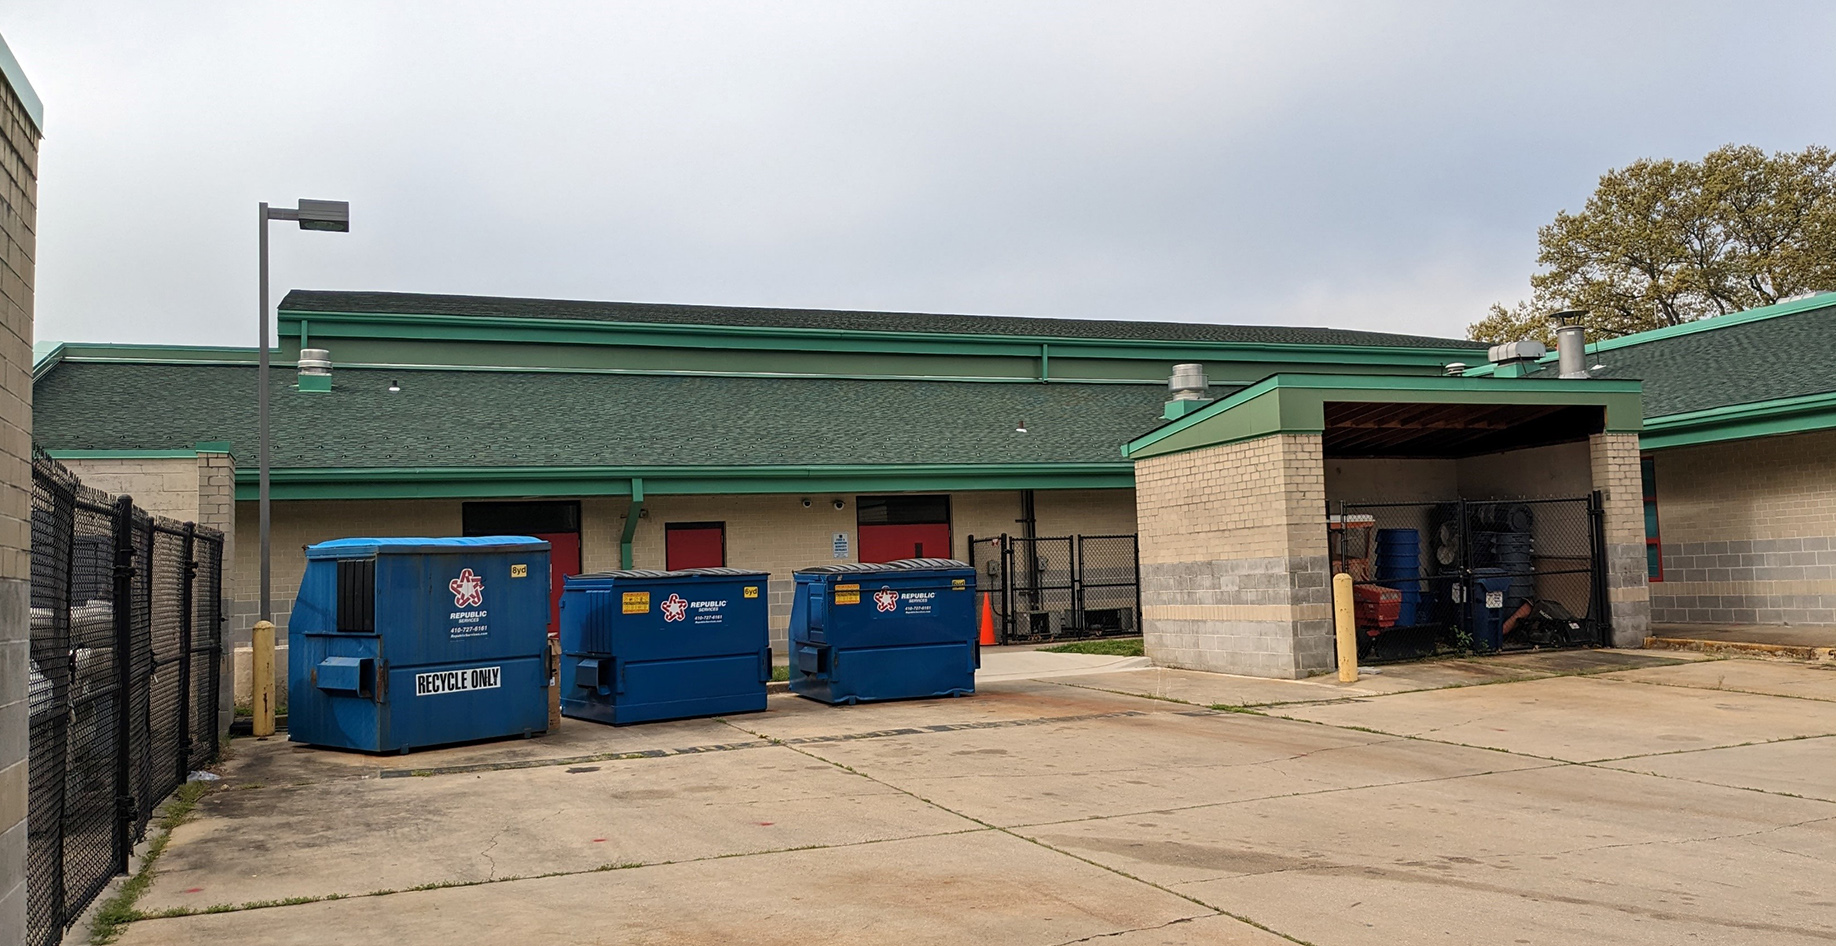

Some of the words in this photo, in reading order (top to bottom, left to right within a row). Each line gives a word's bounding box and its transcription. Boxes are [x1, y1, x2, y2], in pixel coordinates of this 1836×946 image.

[512, 566, 526, 575] 8yd
[450, 611, 487, 619] REPUBLIC
[451, 625, 487, 633] 410-727-6161
[418, 672, 467, 694] RECYCLE
[471, 668, 499, 688] ONLY
